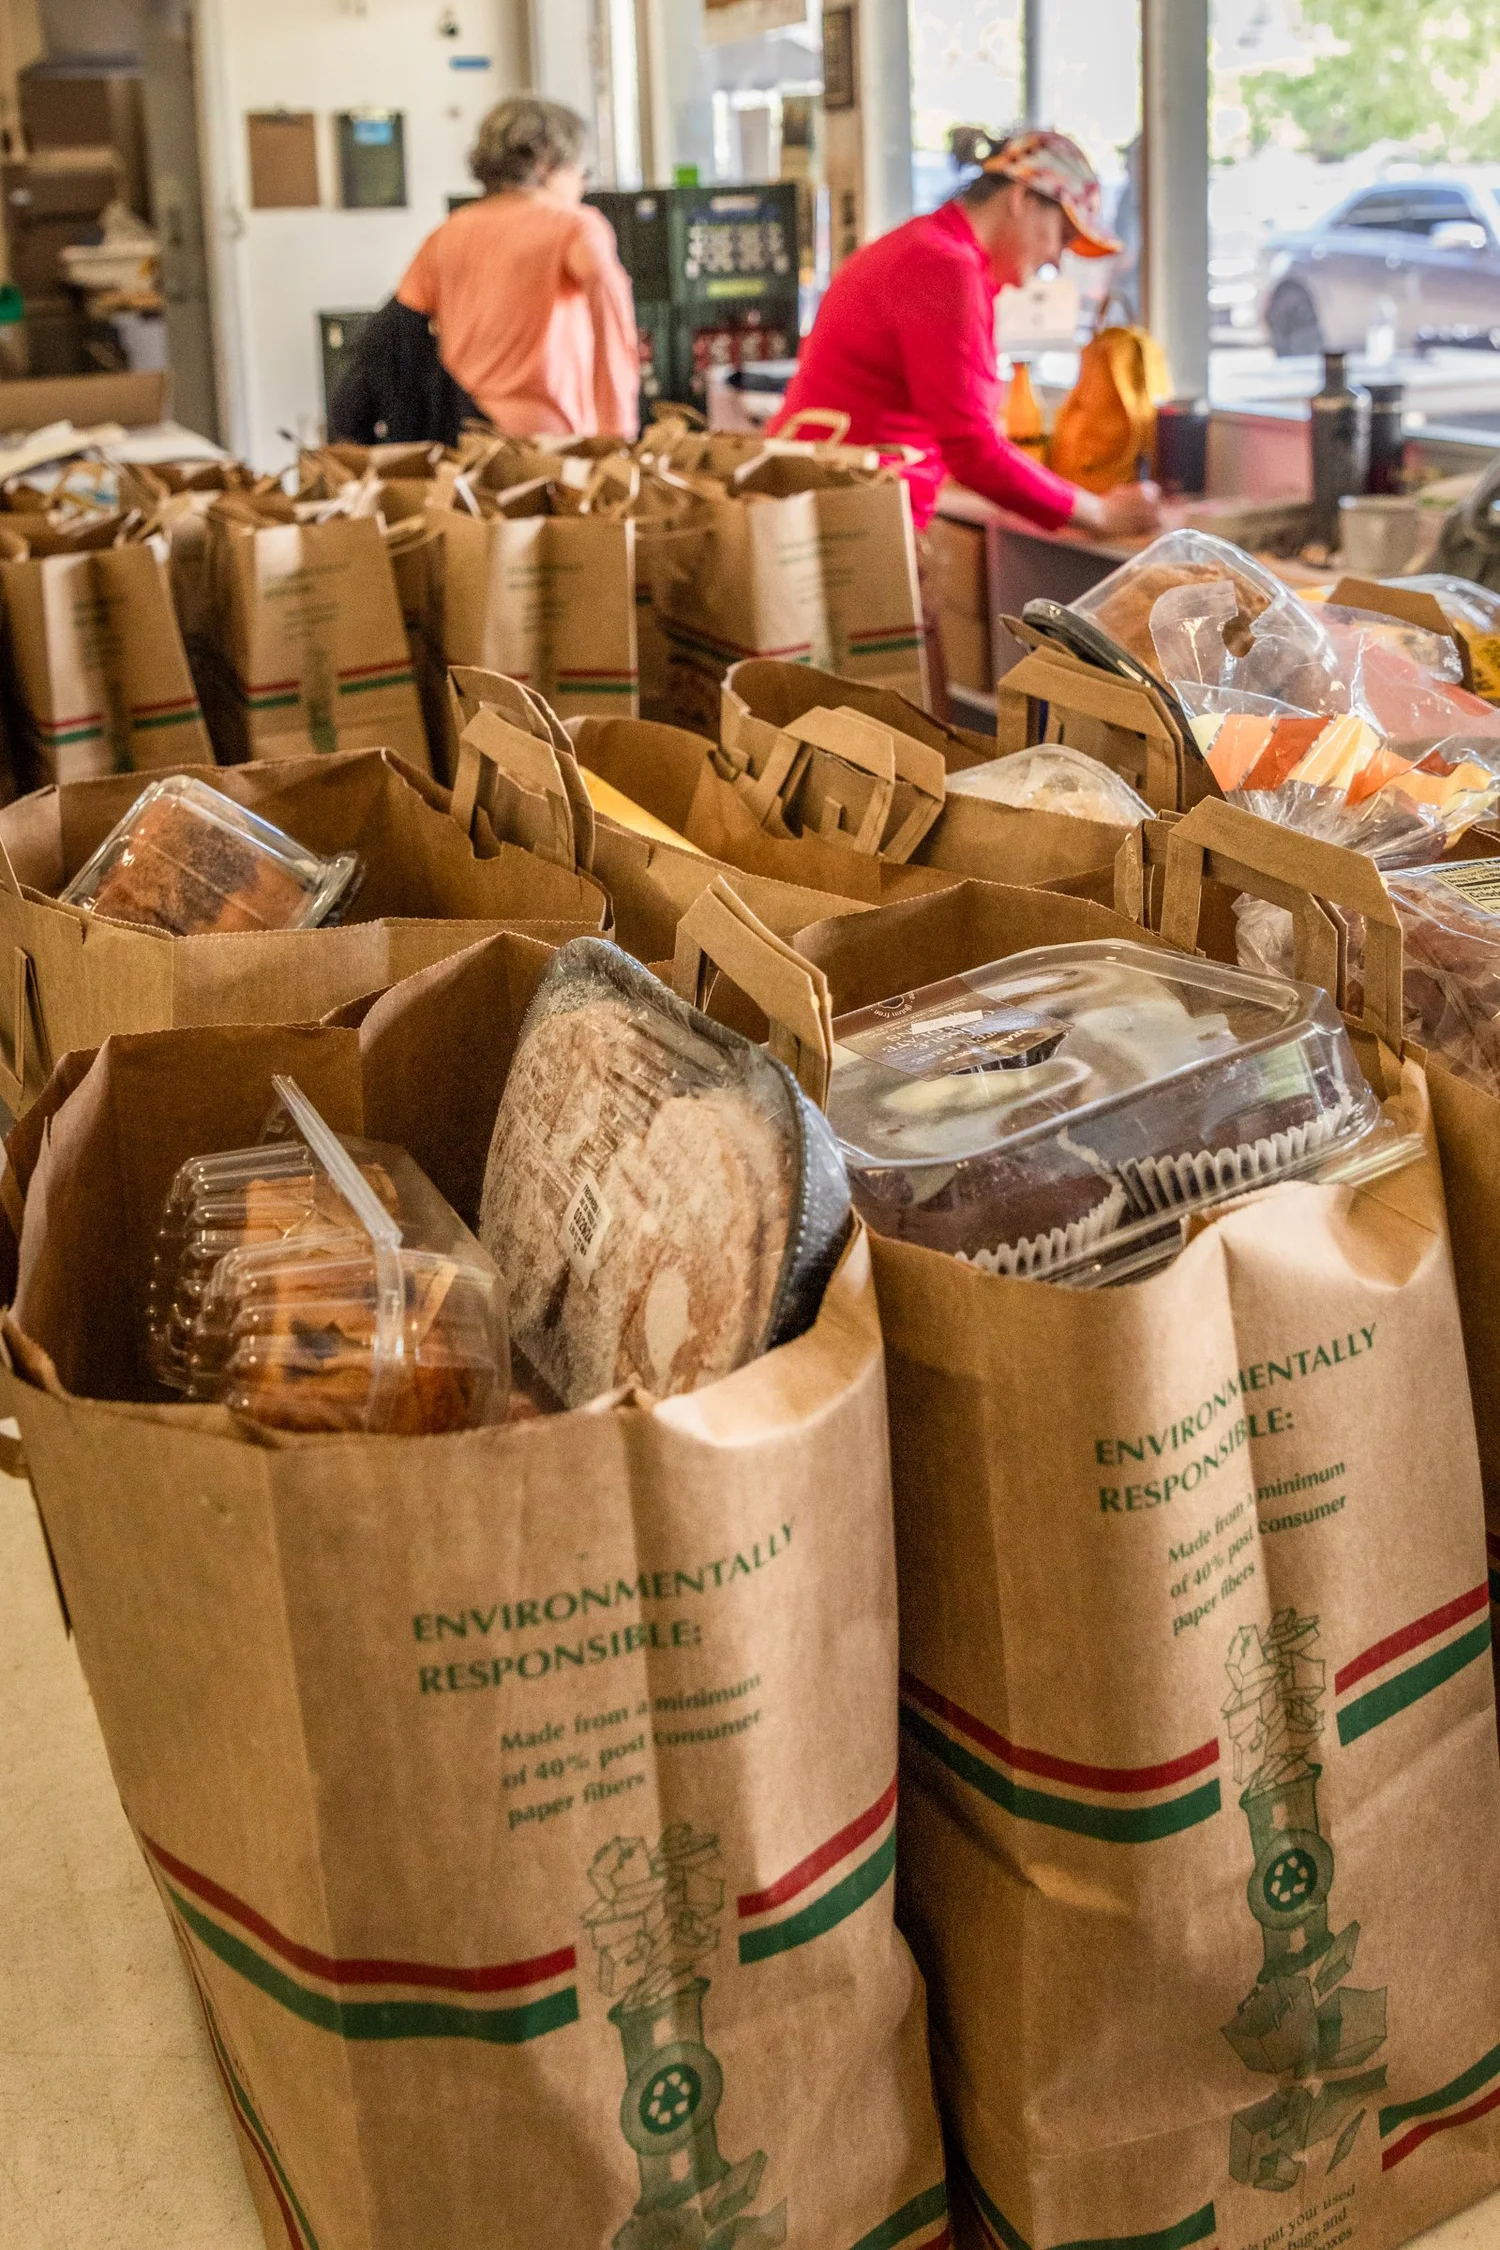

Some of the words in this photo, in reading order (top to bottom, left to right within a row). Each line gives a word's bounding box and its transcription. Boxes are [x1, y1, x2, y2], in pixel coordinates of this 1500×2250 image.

[1094, 1322, 1377, 1466] ENVIRONMENTALLY
[1098, 1406, 1295, 1513] RESPONSIBLE:
[1167, 1529, 1211, 1565] Made
[1214, 1502, 1245, 1536] from
[1255, 1461, 1347, 1501] minimum
[1169, 1580, 1190, 1599] of
[1192, 1555, 1225, 1587] 40%
[1228, 1526, 1255, 1561] post
[1257, 1495, 1347, 1536] consumer
[412, 1515, 796, 1643] ENVIRONMENTALLY
[1171, 1594, 1218, 1637] paper
[1220, 1562, 1256, 1600] fibers
[418, 1617, 703, 1696] RESPONSIBLE:
[500, 1722, 566, 1752] Made
[573, 1704, 630, 1735] from
[653, 1673, 762, 1712] minimum
[502, 1767, 528, 1790] of
[534, 1753, 591, 1781] 40%
[599, 1733, 647, 1770] post
[653, 1708, 763, 1748] consumer
[507, 1795, 575, 1832] paper
[582, 1772, 647, 1805] fibers
[1322, 2206, 1347, 2233] and
